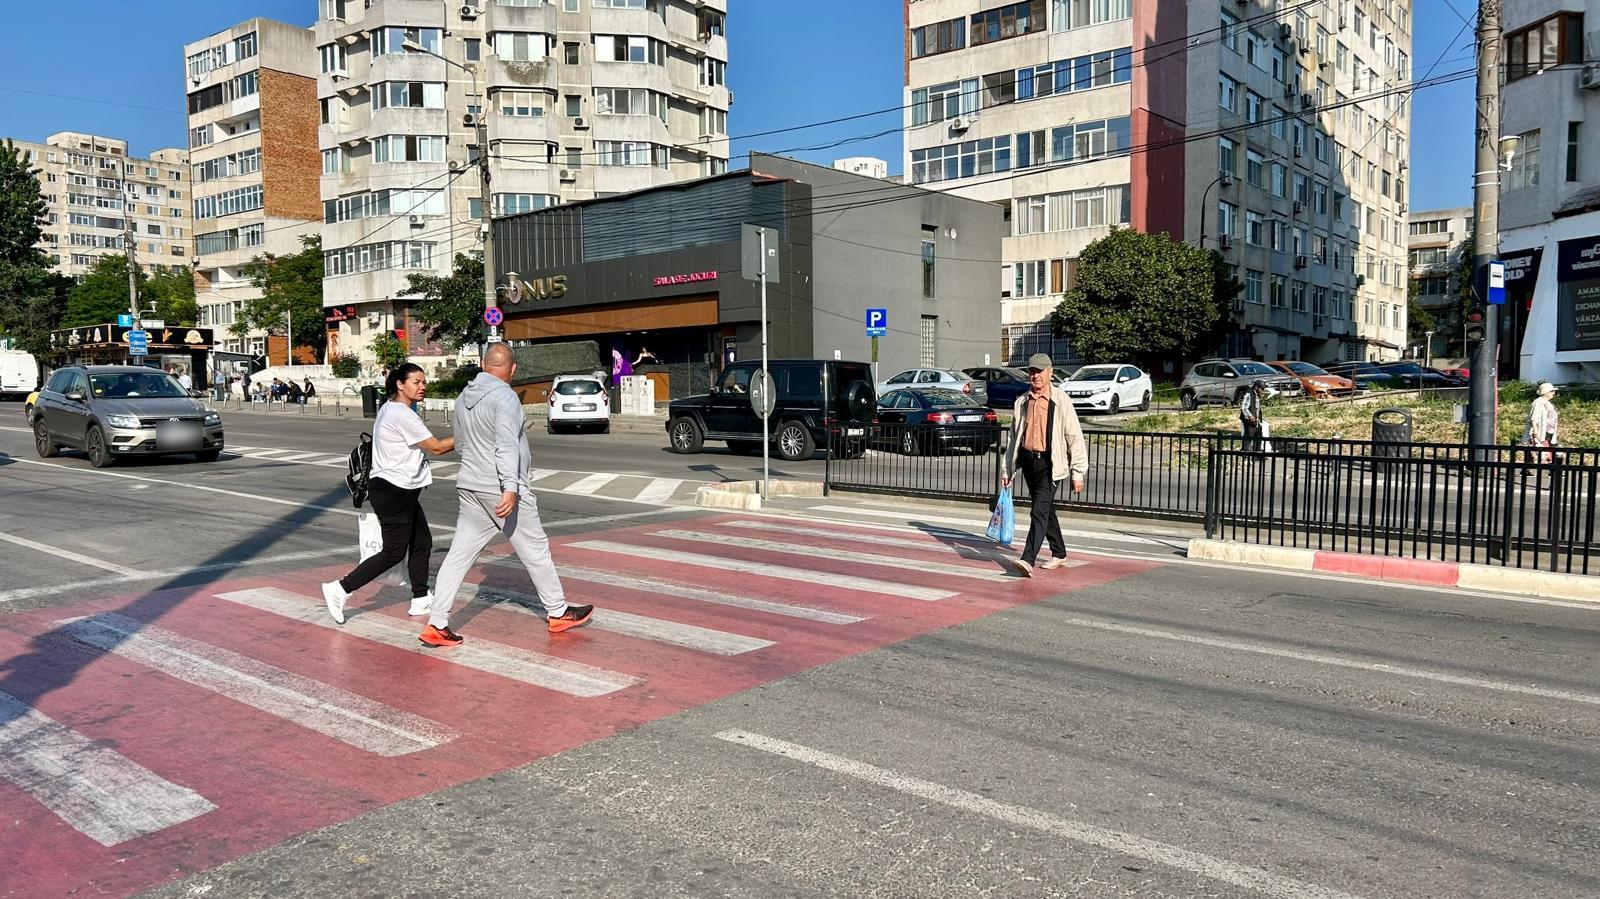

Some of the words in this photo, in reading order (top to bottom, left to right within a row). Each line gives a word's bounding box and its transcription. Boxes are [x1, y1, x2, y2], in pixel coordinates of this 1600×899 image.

[1504, 256, 1533, 269] ONEY
[1504, 269, 1524, 280] OLD
[497, 274, 568, 304] ONUS
[870, 311, 882, 327] P
